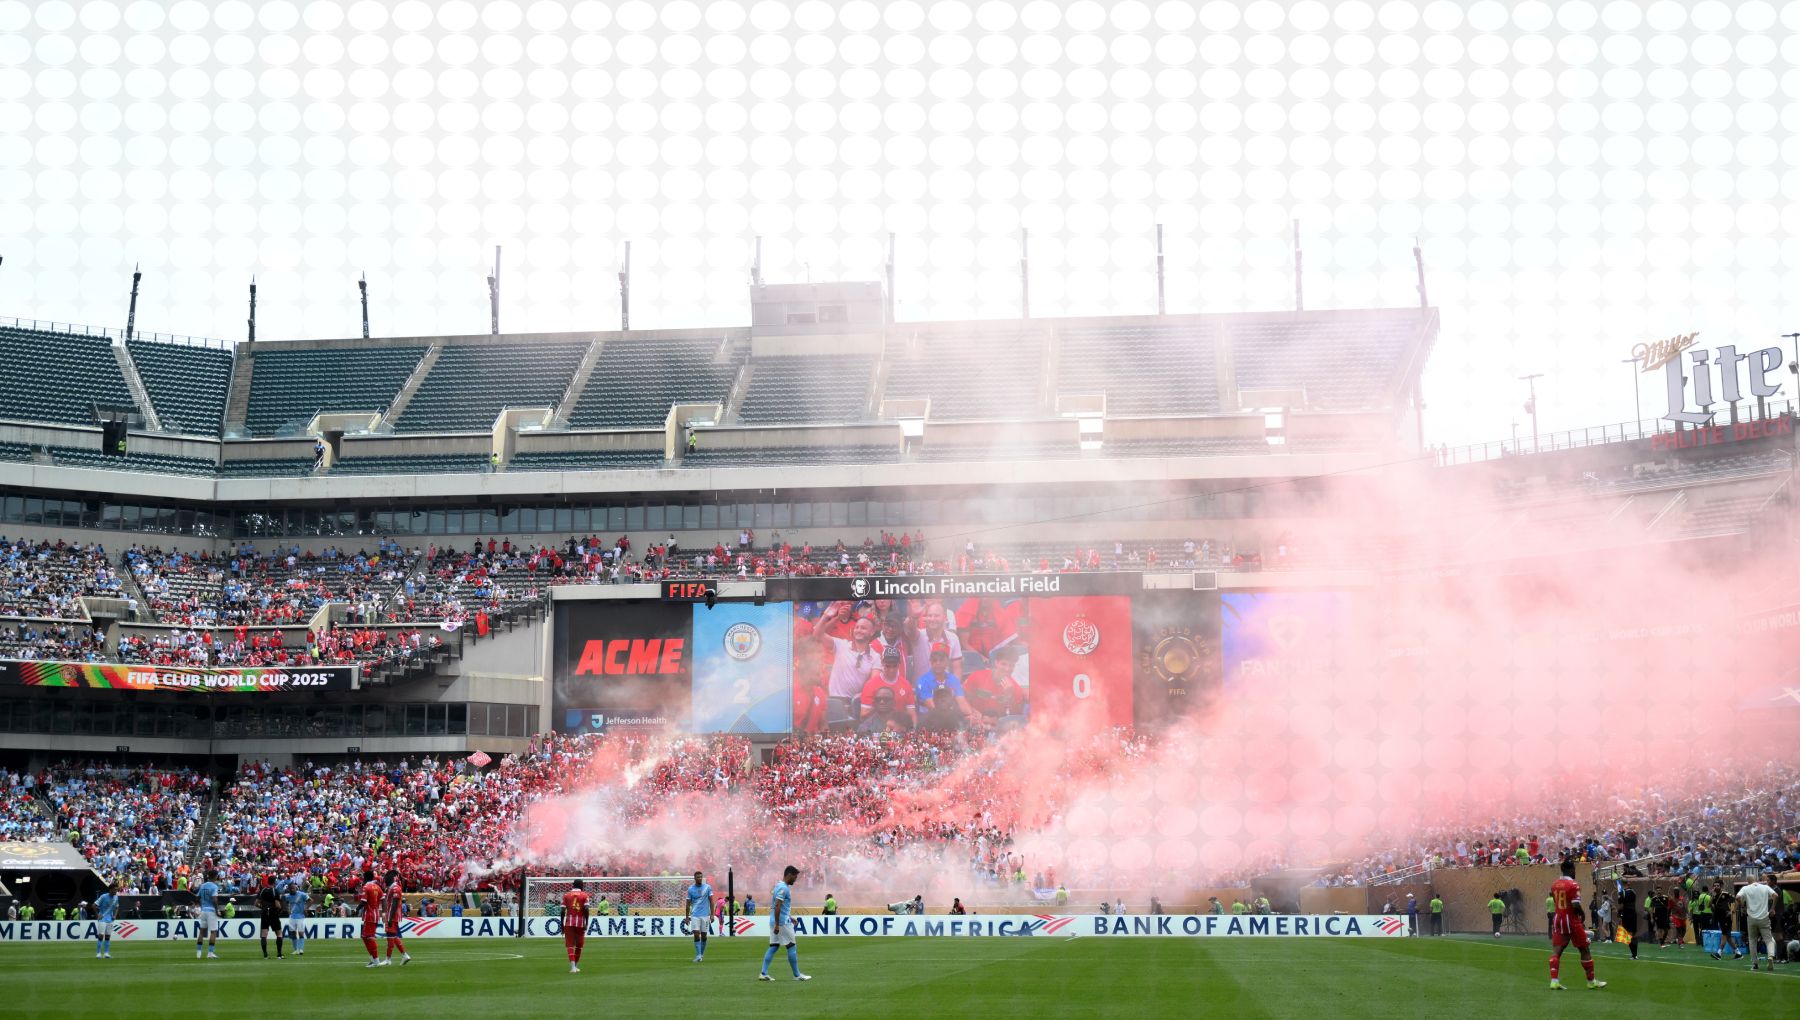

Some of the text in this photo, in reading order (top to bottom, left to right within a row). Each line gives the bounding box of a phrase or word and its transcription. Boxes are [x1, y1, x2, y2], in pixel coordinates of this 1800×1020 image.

[1631, 332, 1700, 370] Miller
[1662, 345, 1783, 425] Lite
[1733, 416, 1792, 442] DECK
[669, 583, 707, 598] FIFA
[875, 576, 1060, 596] Lincoln Financial Field
[575, 638, 682, 676] ACME
[127, 671, 159, 685] FIFA
[162, 672, 200, 687] CLUB
[204, 673, 257, 688] WORLD
[259, 673, 288, 687] CUP
[1073, 674, 1091, 699] 0
[733, 678, 751, 704] 2
[1168, 688, 1187, 696] FIFA
[605, 716, 667, 726] Jefferson Health
[572, 897, 581, 911] 4
[1553, 889, 1568, 910] 18
[238, 920, 256, 939] O
[461, 918, 535, 936] BANK
[793, 916, 1034, 938] ANK OF AMERICA
[1094, 916, 1363, 935] BANK OF AMERICA
